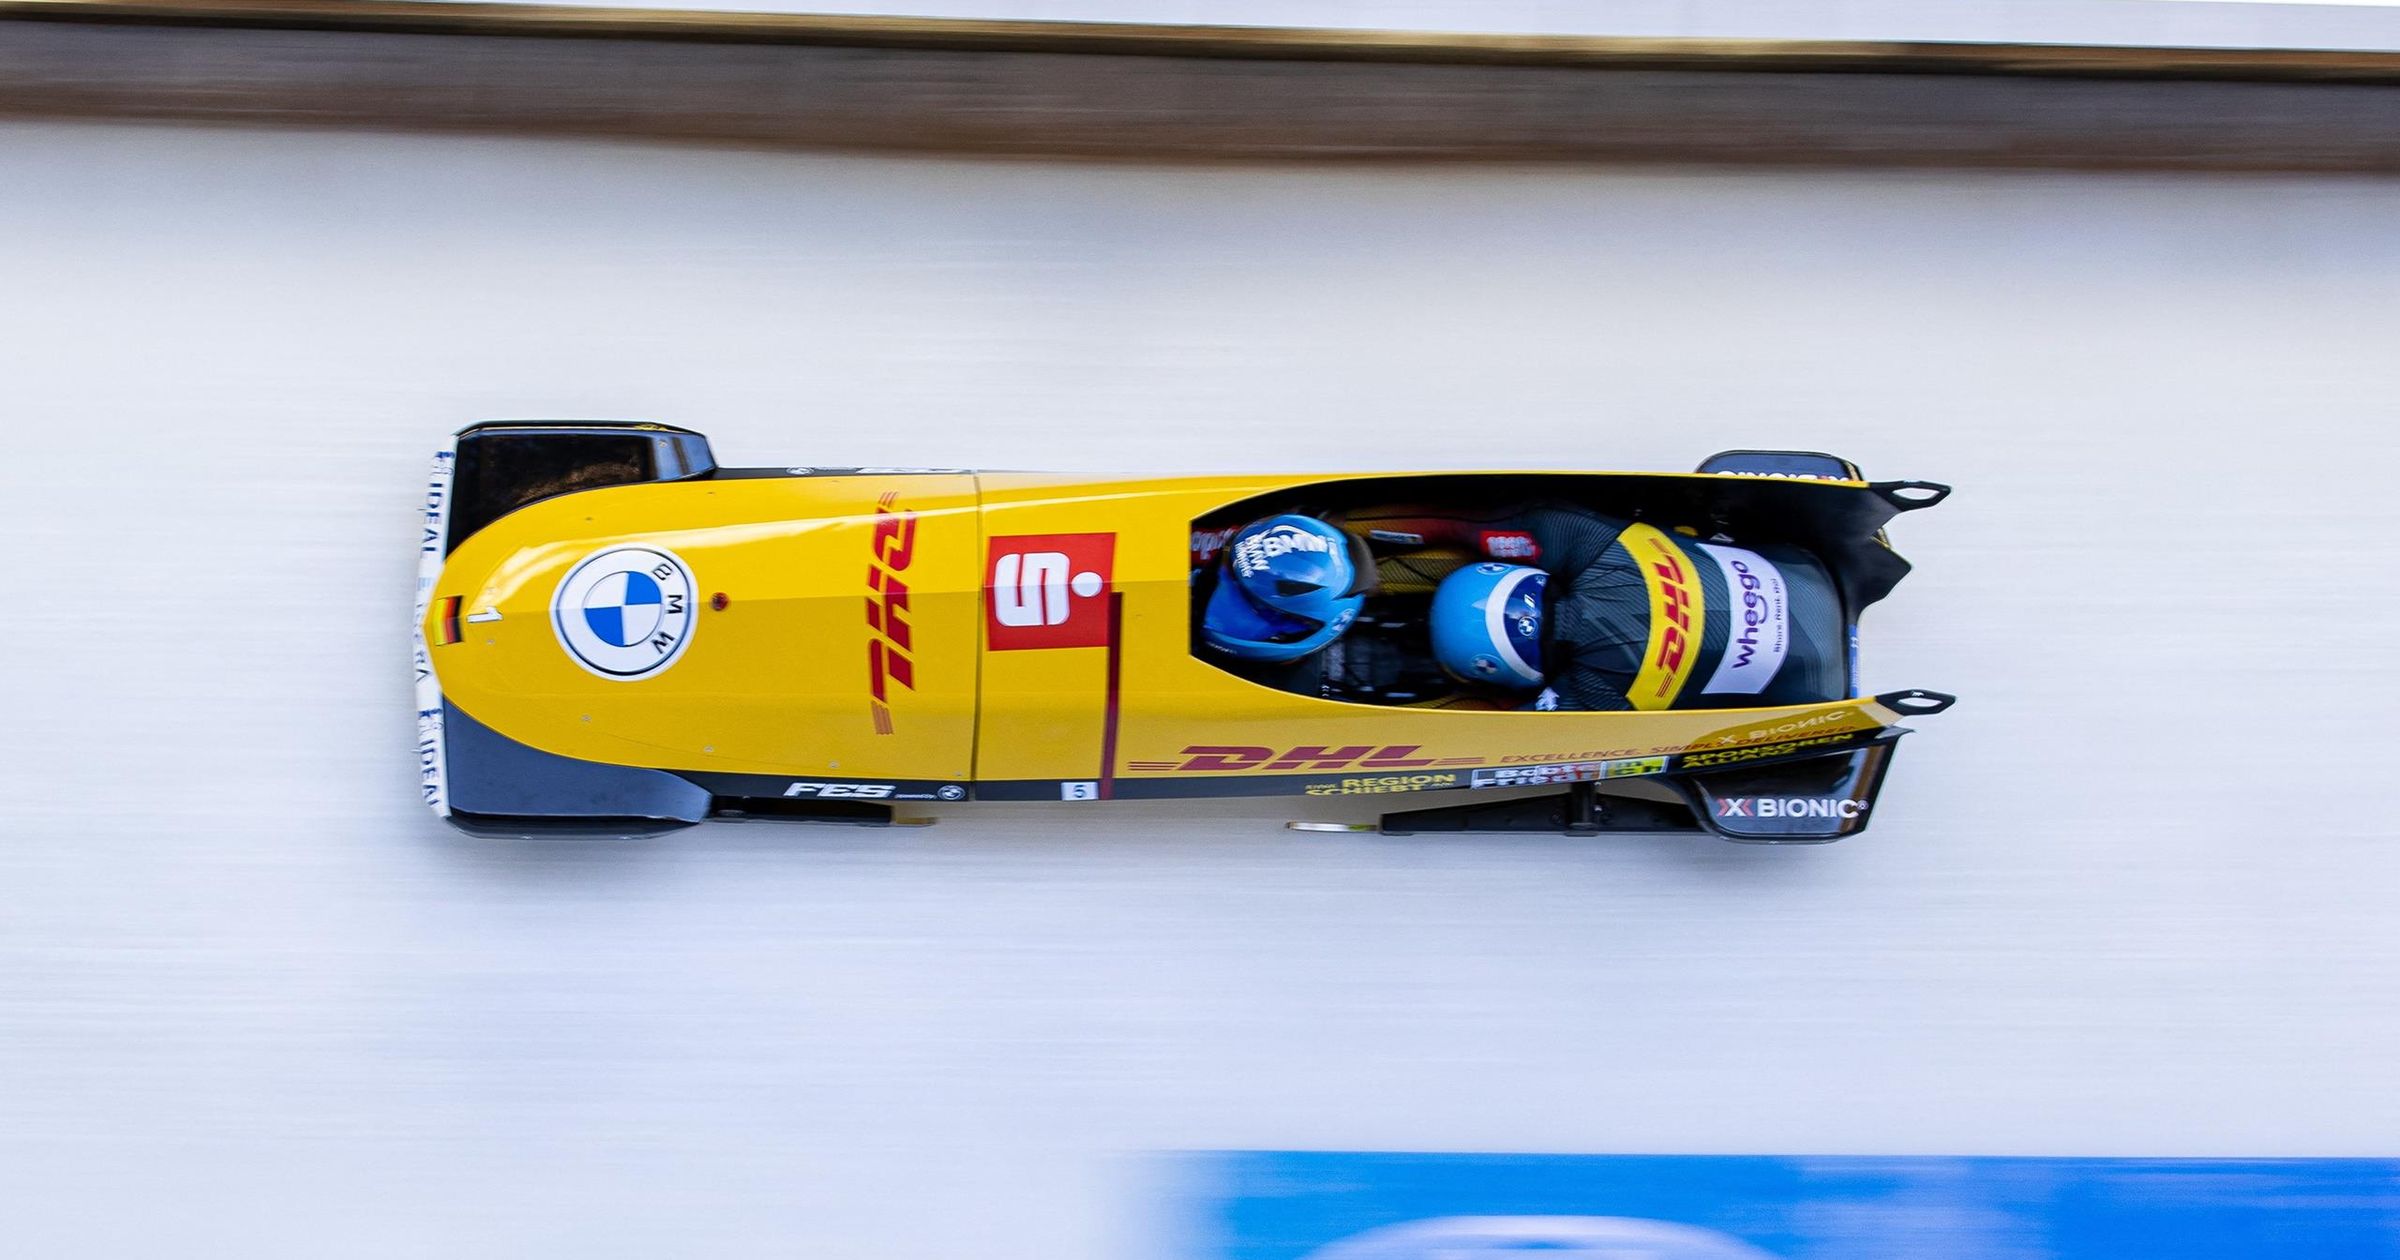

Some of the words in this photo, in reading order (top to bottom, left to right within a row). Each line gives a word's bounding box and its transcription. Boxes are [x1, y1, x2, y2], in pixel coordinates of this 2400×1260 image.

[466, 607, 503, 624] 1
[652, 563, 684, 654] BMW
[865, 508, 917, 704] DHL
[1653, 554, 1690, 673] DHL
[1176, 745, 1434, 771] DHL
[1683, 734, 1854, 763] SPONSOREN
[783, 782, 896, 798] FES
[1305, 784, 1424, 796] SCHIEBT
[1341, 774, 1456, 789] REGION
